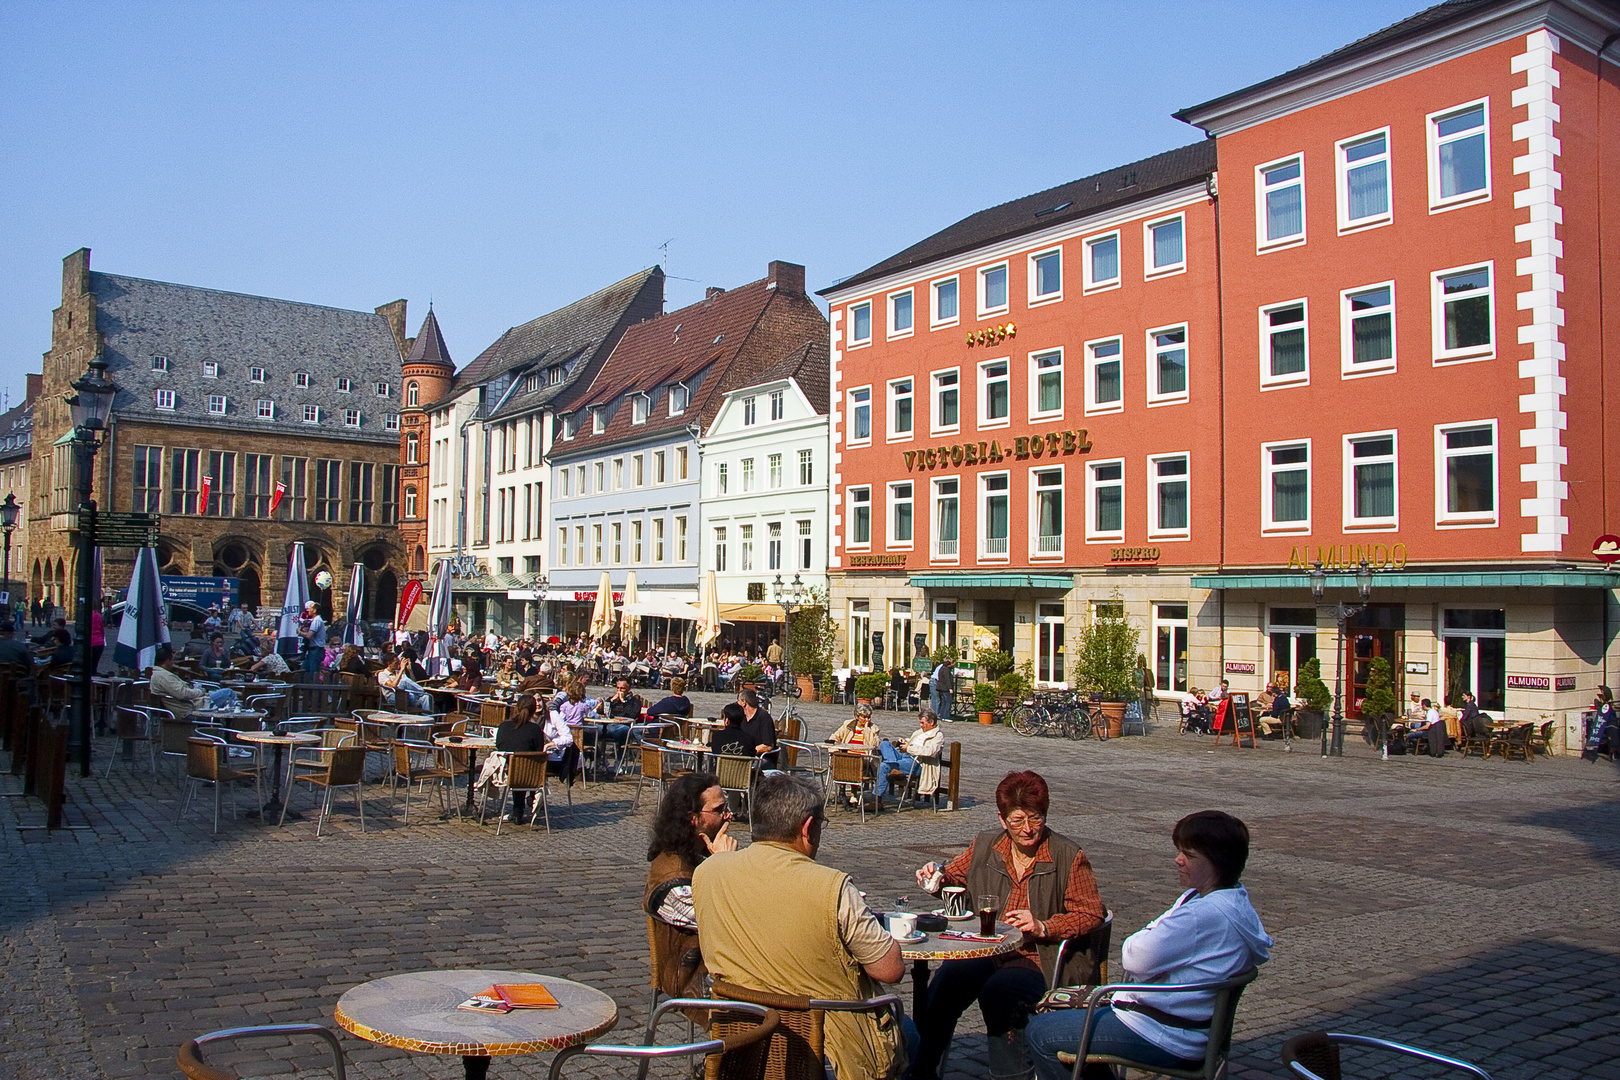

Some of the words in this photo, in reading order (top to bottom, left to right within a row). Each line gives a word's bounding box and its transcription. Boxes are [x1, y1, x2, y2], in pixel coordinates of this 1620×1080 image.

[903, 429, 1092, 472] VICTORIA-HOTEL
[850, 555, 906, 567] RESTAURANT
[1111, 547, 1161, 562] BISTRO
[1288, 543, 1407, 569] ALMUNDO
[1226, 663, 1255, 672] ALMUNDO
[1508, 677, 1549, 687] ALMUNDO
